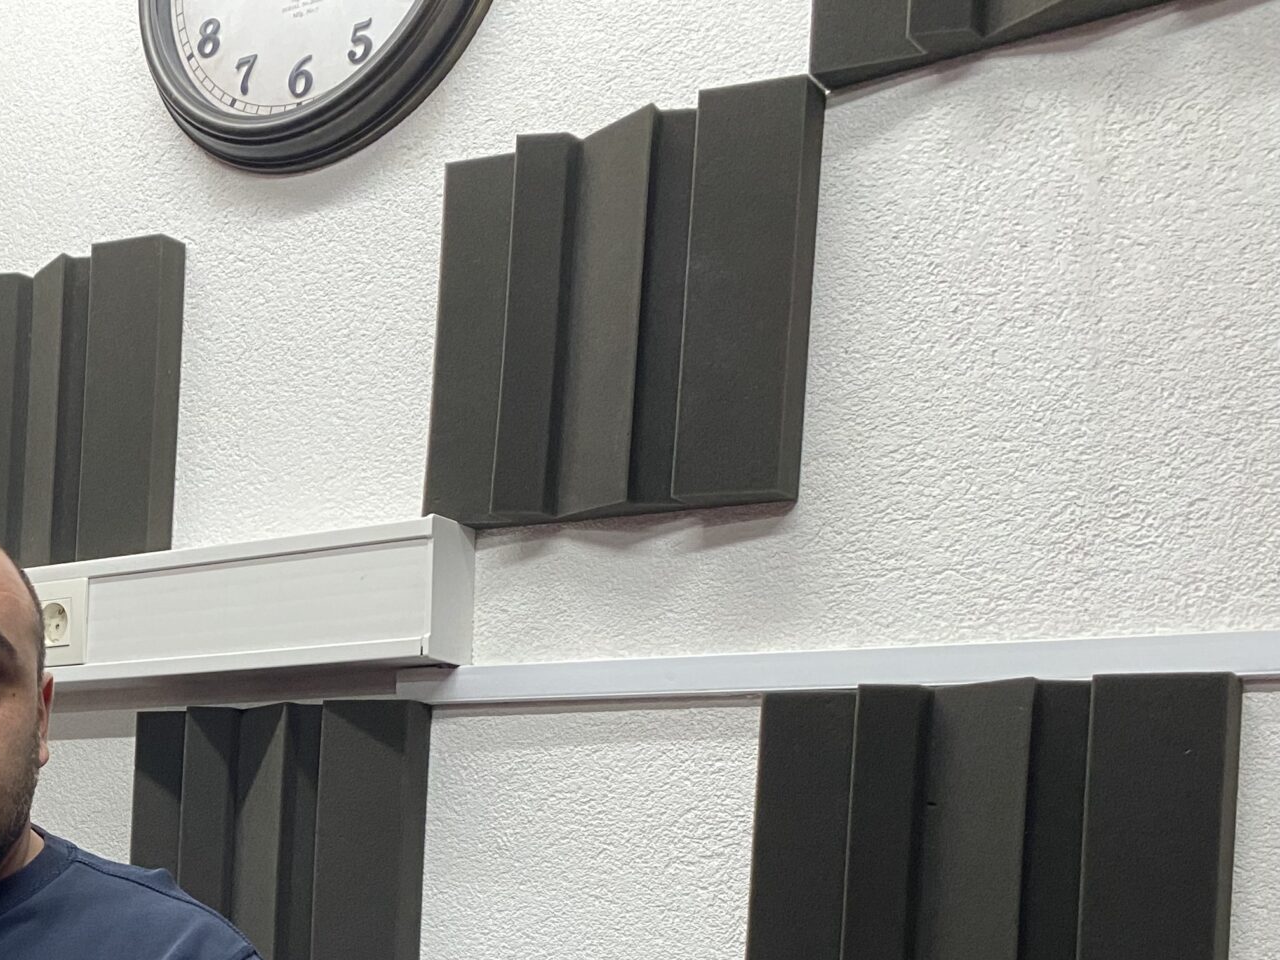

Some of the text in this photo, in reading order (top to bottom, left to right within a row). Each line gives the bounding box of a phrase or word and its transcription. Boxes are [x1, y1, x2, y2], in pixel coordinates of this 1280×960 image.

[197, 18, 220, 58] 8
[347, 17, 373, 65] 5
[235, 54, 258, 95] 7
[288, 54, 313, 98] 6
